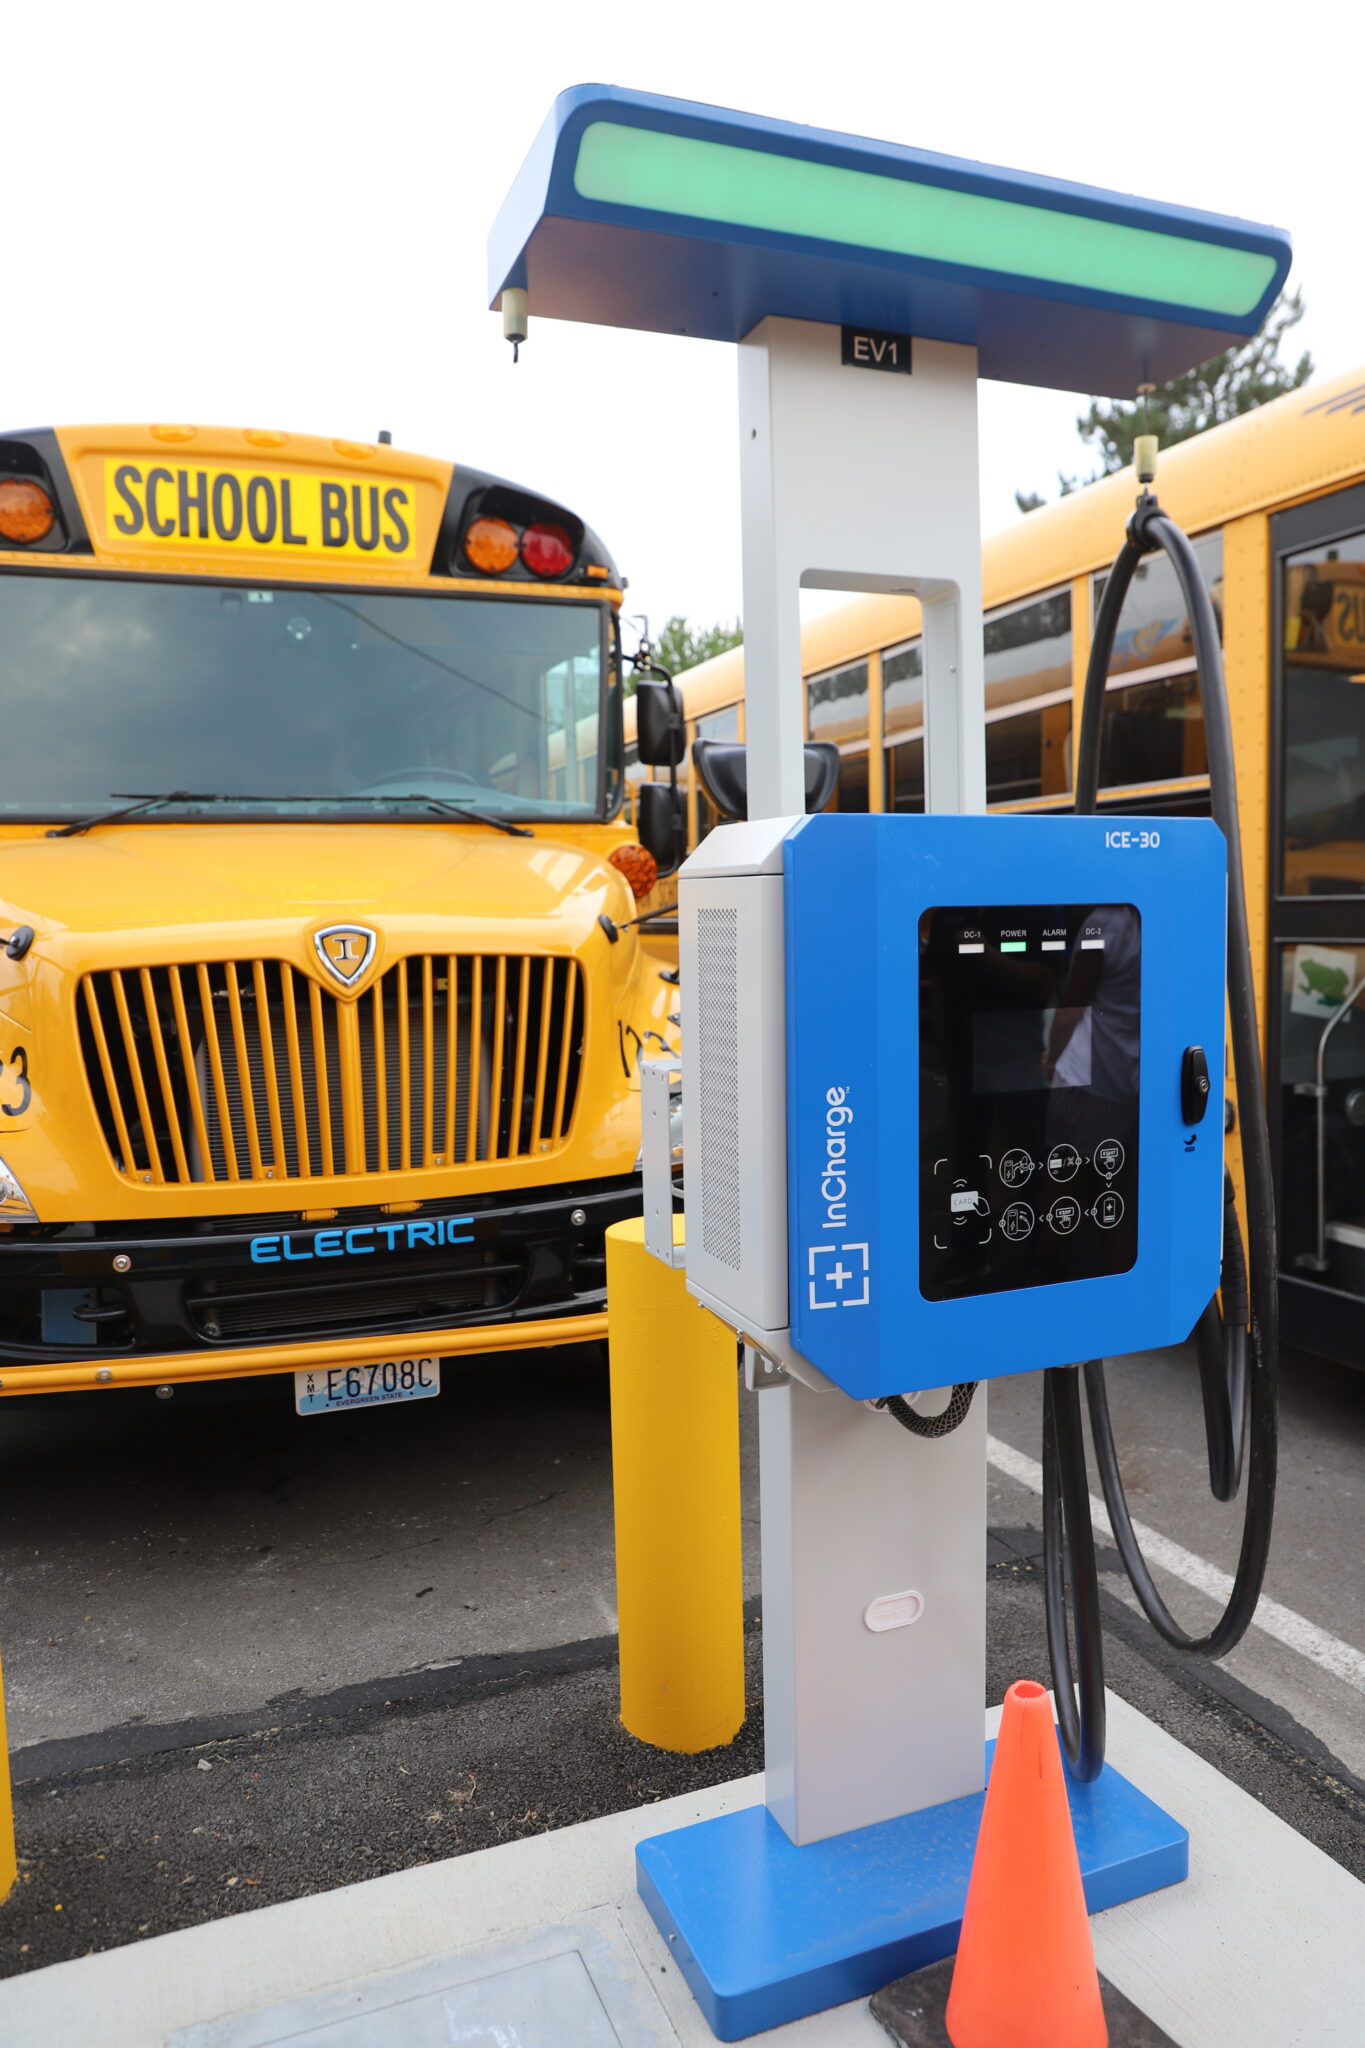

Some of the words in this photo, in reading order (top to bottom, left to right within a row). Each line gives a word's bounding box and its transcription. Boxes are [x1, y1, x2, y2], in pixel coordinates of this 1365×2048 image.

[854, 335, 897, 365] EV1
[113, 464, 308, 546] SCHOOL
[320, 481, 410, 553] BUS
[1105, 831, 1161, 849] ICE-30
[964, 930, 981, 939] DC-1
[1000, 929, 1027, 938] POWER
[1042, 928, 1067, 937] ALARM
[1085, 927, 1102, 936] DC-2
[0, 1046, 32, 1117] 3
[821, 1085, 854, 1229] InCharge
[250, 1217, 475, 1264] ELECTRIC
[327, 1358, 433, 1401] E6708C
[336, 1394, 380, 1407] EVERGREEN
[381, 1391, 403, 1401] STATE
